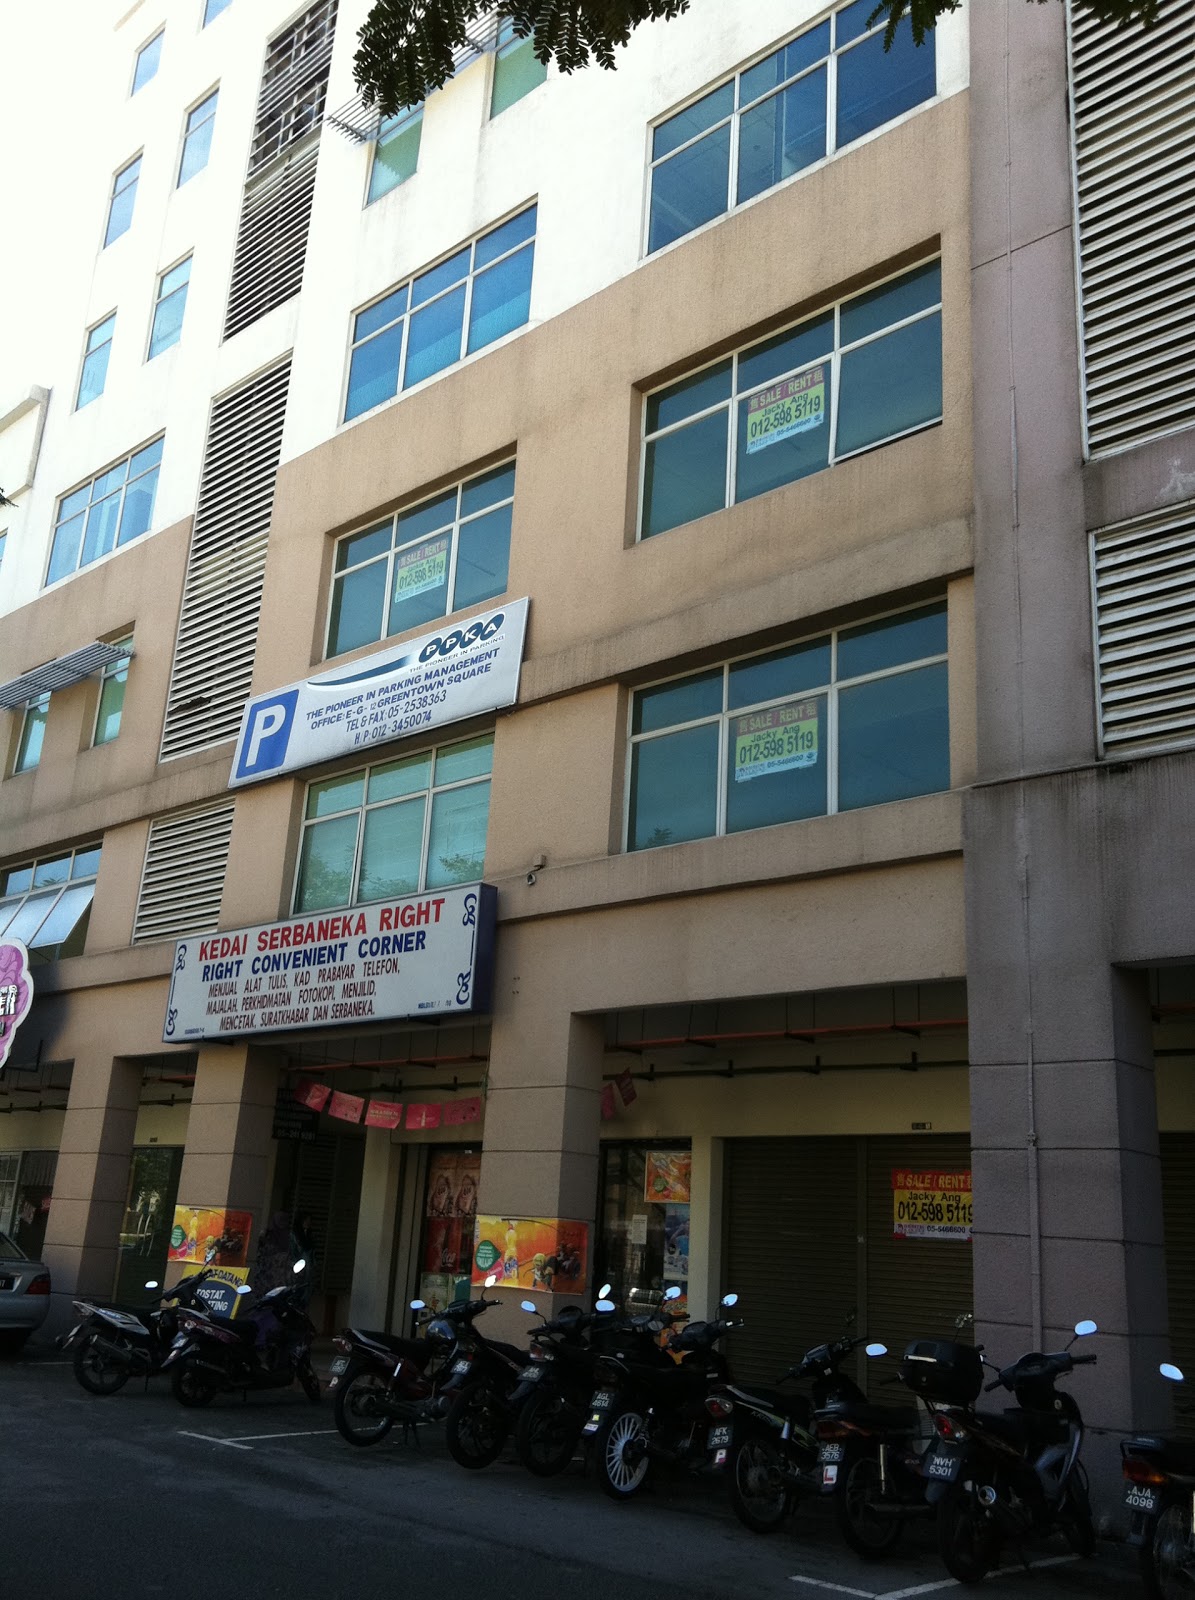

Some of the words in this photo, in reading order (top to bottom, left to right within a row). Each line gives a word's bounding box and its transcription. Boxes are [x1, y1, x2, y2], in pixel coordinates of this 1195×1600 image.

[760, 387, 782, 406] SALE
[788, 375, 812, 394] RENT
[762, 401, 785, 417] Jacky
[790, 393, 808, 406] Ang
[751, 407, 792, 437] 012-598
[795, 395, 820, 419] 5119
[410, 664, 423, 673] THE
[425, 653, 459, 668] PIONEER
[469, 635, 504, 653] PARKING
[423, 619, 501, 658] PPKA
[306, 707, 324, 720] THE
[325, 694, 364, 714] PIONEER
[366, 690, 376, 701] IN
[377, 674, 421, 699] PARKING
[424, 647, 500, 681] MANAGEMENT
[377, 678, 445, 708] GREENTOWN
[447, 662, 492, 685] SQUARE
[749, 712, 773, 730] SALE
[779, 706, 804, 723] RENT
[751, 729, 777, 742] Jacky
[782, 725, 800, 736] Ang
[245, 704, 287, 768] P
[740, 738, 784, 764] 012-598
[787, 730, 814, 753] 5119
[199, 934, 248, 961] KEDAI
[257, 912, 367, 951] SERBANEKA
[379, 898, 445, 931] RIGHT
[202, 960, 243, 982] RIGHT
[251, 942, 348, 975] CONVENIENT
[358, 930, 426, 958] CORNER
[208, 981, 238, 998] MENJUAL
[244, 977, 262, 993] ALAT
[294, 970, 311, 987] KAD
[317, 964, 355, 983] PRABAYAR
[363, 957, 400, 977] TELEFON,
[241, 991, 291, 1011] PERKHIDMATAN
[260, 1007, 309, 1027] SURATKHABAR
[312, 1005, 329, 1021] DAN
[907, 1174, 932, 1188] SALE
[939, 1175, 965, 1189] RENT
[898, 1201, 944, 1222] 012-598
[908, 1192, 936, 1203] Jacky
[941, 1193, 961, 1204] Ang
[1126, 1495, 1153, 1509] 4098
[1131, 1486, 1151, 1498] AJA
